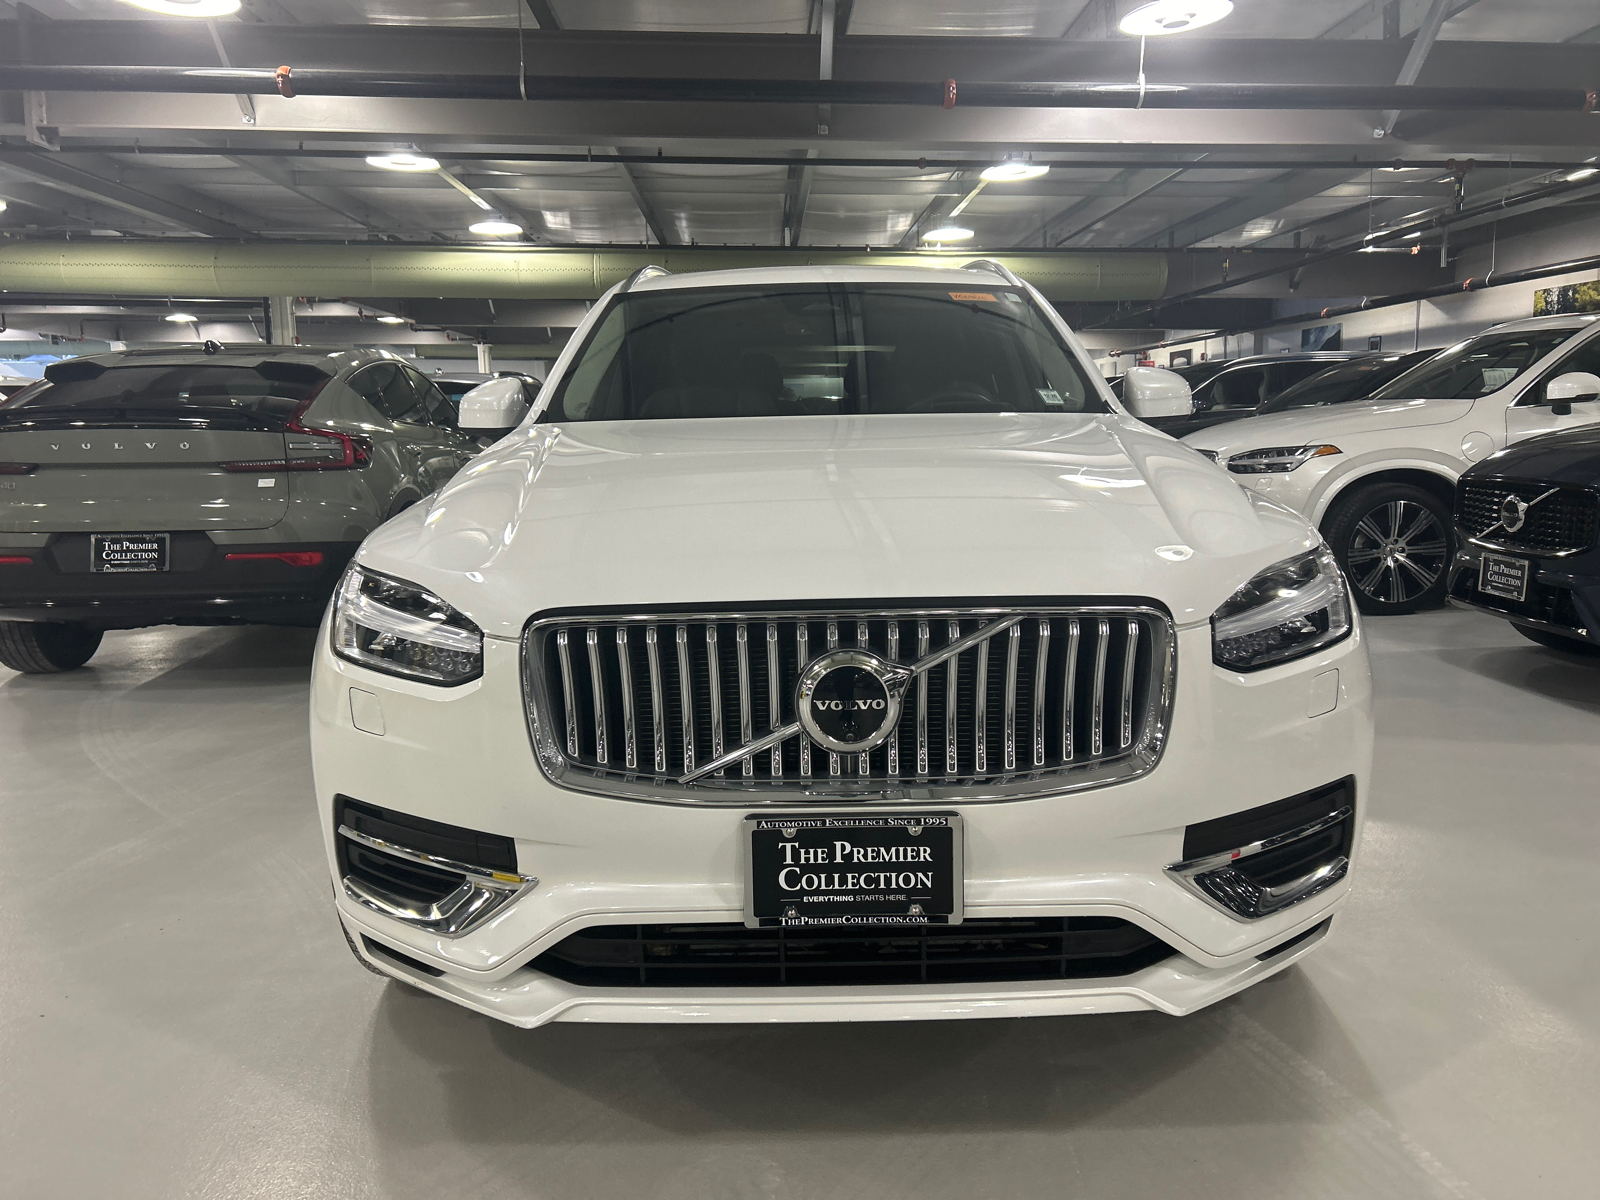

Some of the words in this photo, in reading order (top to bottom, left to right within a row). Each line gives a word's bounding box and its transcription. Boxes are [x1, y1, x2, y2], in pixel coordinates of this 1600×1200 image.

[50, 441, 190, 451] VOLVO
[102, 541, 122, 551] THE
[122, 541, 159, 550] PREMIER
[102, 550, 159, 560] COLLECTION
[1488, 561, 1500, 573] THE
[1500, 563, 1522, 577] PREMIER
[1487, 570, 1521, 587] COLLECTION
[813, 699, 886, 711] VOLVO
[759, 820, 823, 829] AUTOMOTIVE
[825, 818, 885, 828] EXCELLENCE
[887, 817, 917, 826] SINCE
[920, 817, 947, 826] 1995
[778, 841, 829, 865] THE
[833, 840, 934, 864] PREMIER
[778, 866, 934, 891] COLLECTION
[803, 895, 854, 903] EVERYTHING
[855, 894, 884, 902] STARTS
